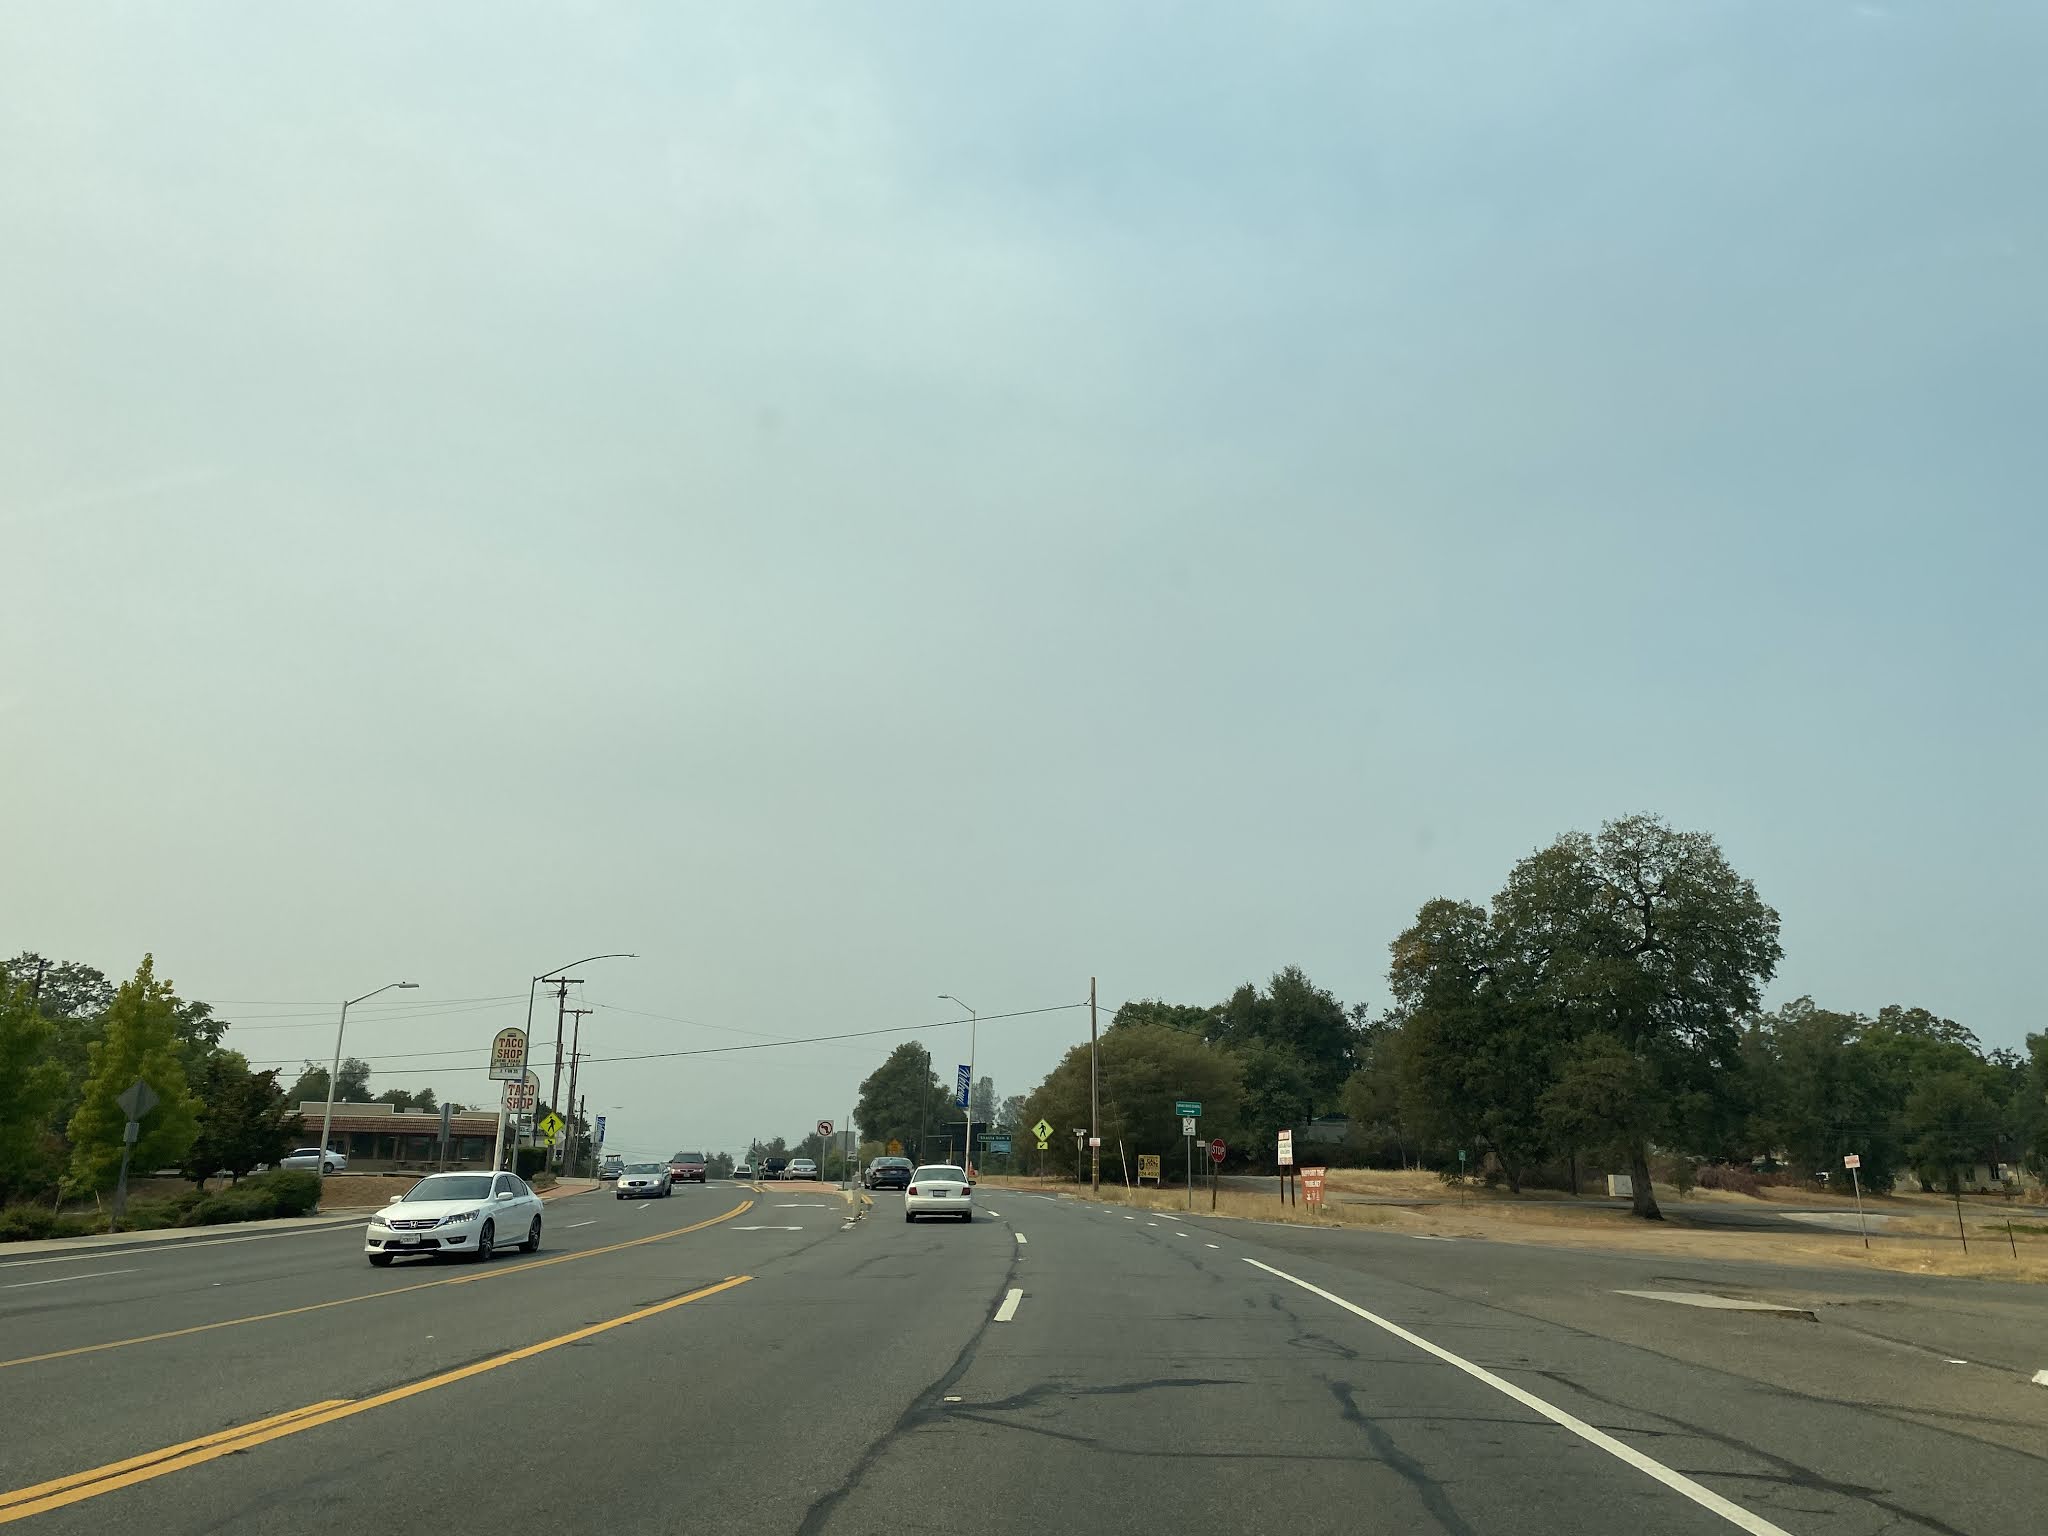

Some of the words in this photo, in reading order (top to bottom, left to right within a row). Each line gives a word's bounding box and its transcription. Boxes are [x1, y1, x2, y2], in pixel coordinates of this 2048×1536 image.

[499, 1038, 523, 1048] TACO
[497, 1049, 523, 1058] SHOP
[509, 1084, 535, 1095] TACO
[507, 1097, 533, 1109] SHOP
[1212, 1145, 1225, 1155] STOP
